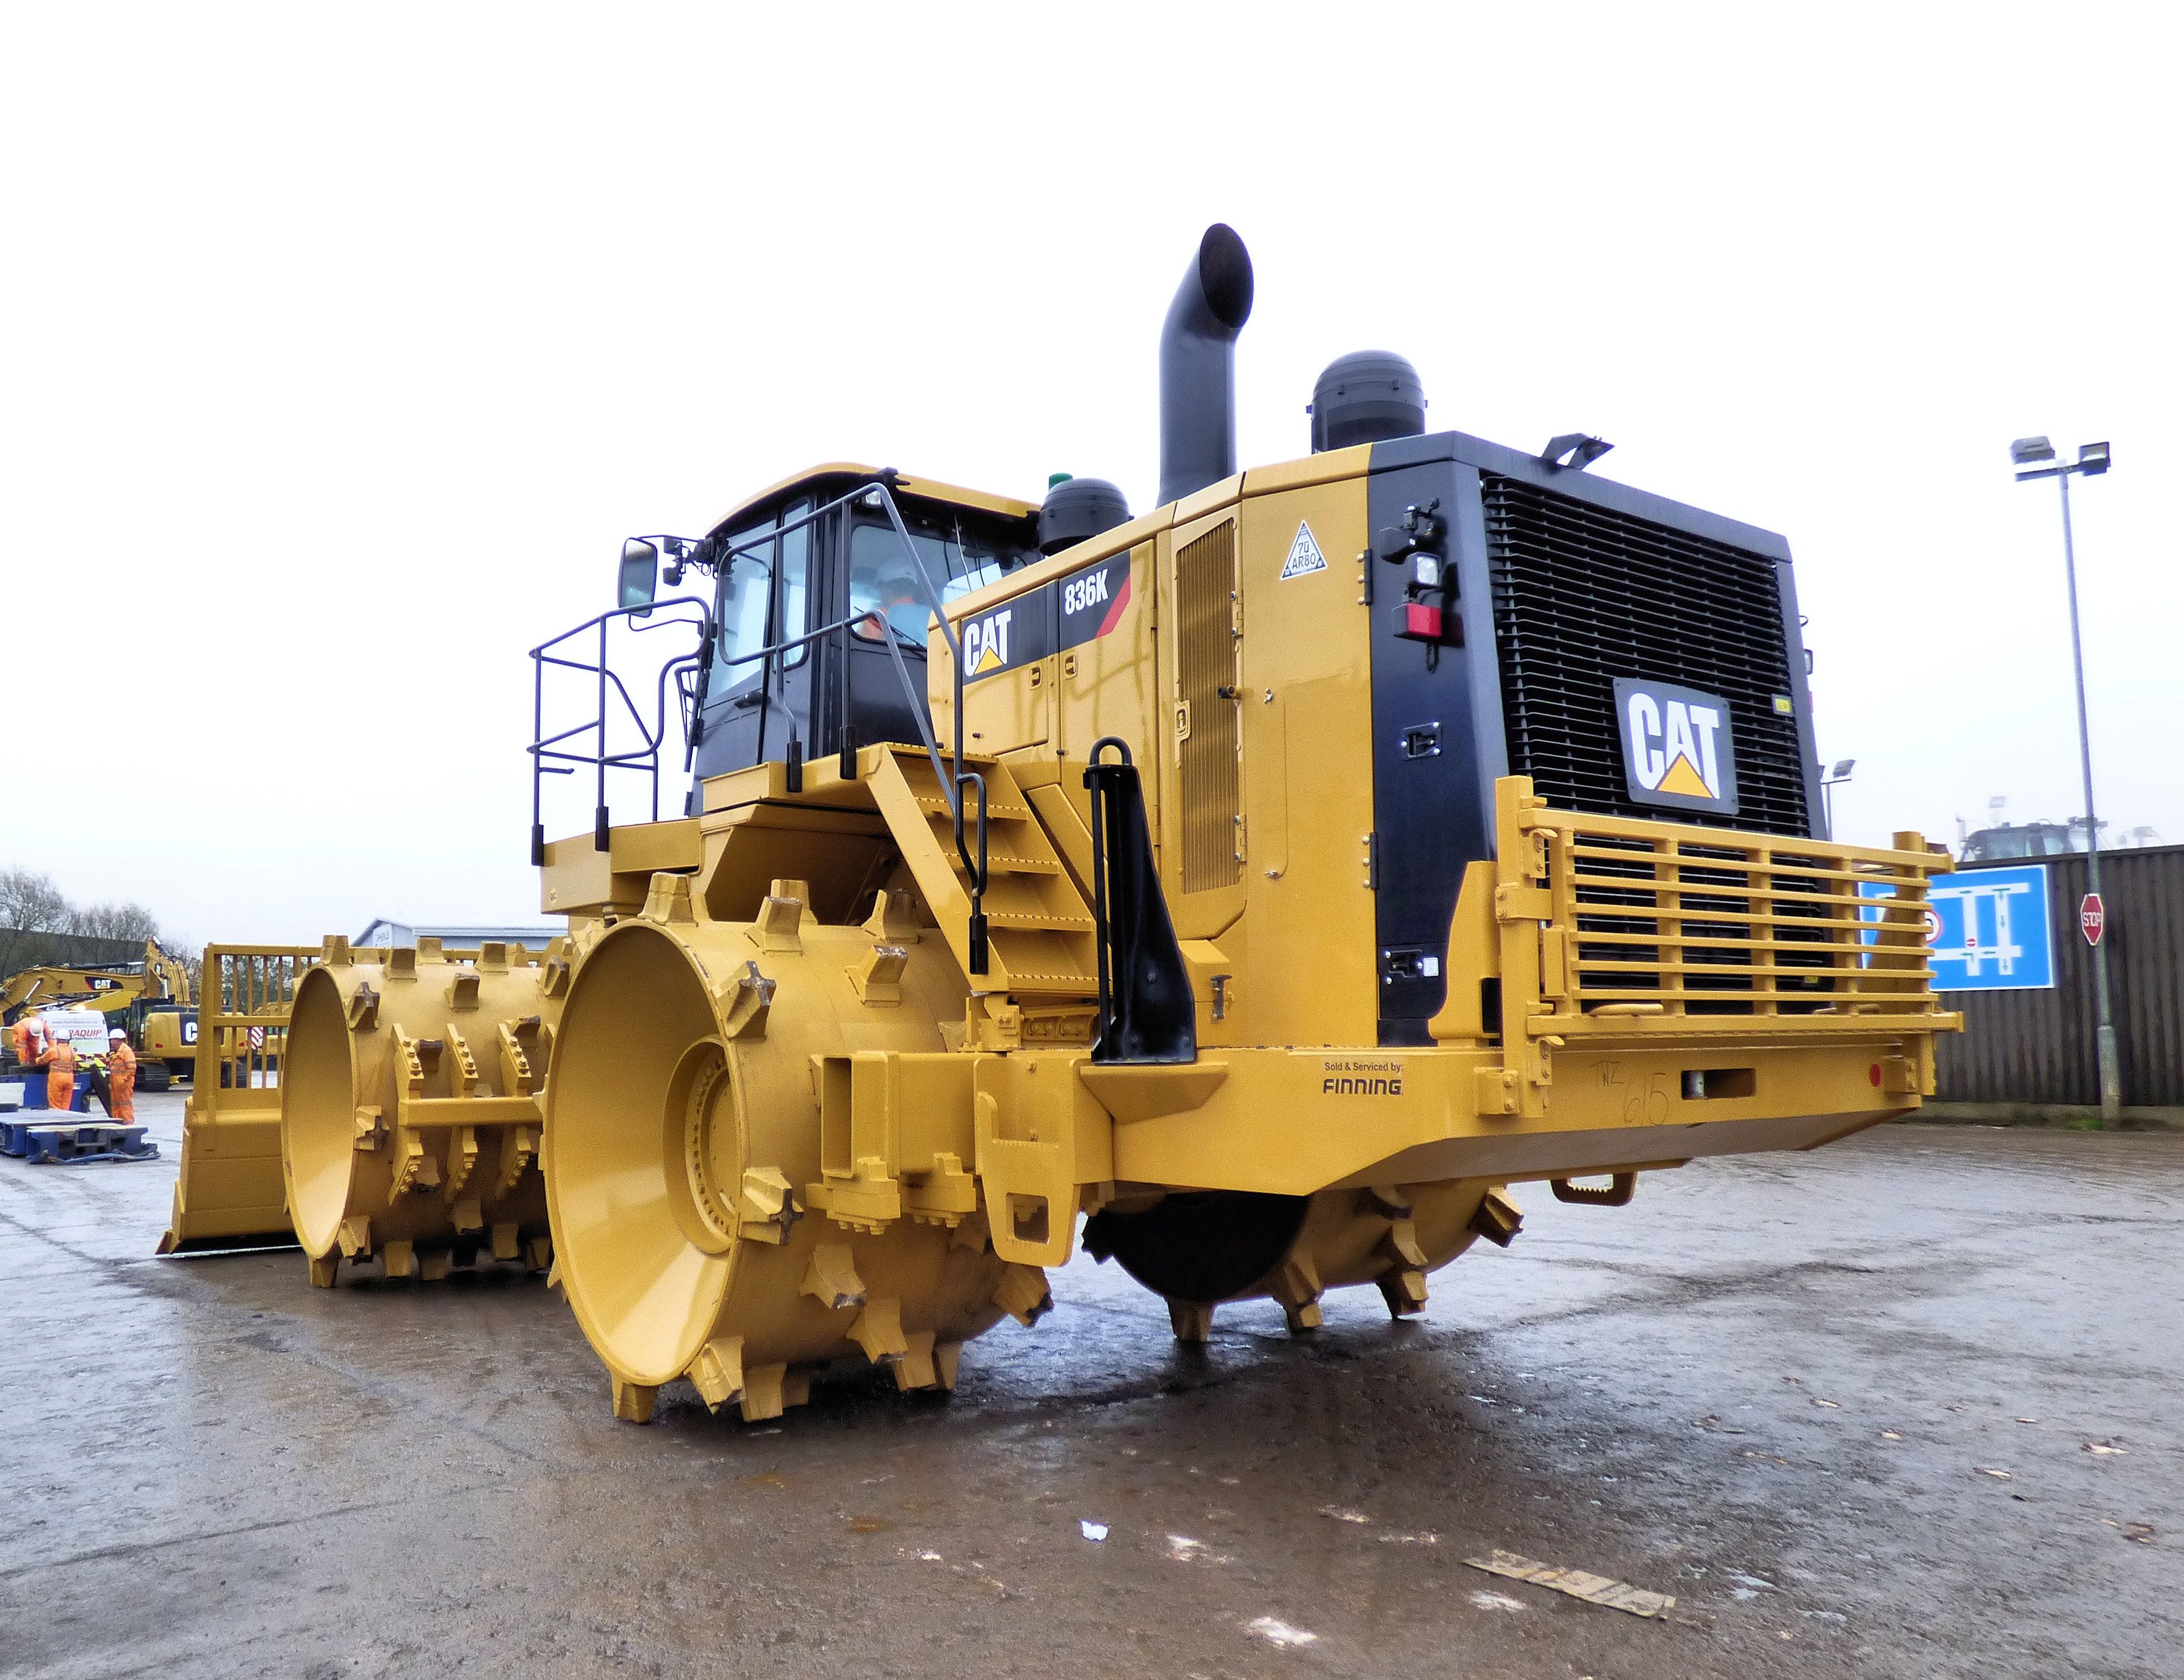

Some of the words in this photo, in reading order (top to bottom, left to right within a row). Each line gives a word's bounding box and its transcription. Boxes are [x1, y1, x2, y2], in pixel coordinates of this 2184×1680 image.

[1065, 569, 1108, 615] 836K
[964, 610, 1011, 676] CAT
[1629, 693, 1720, 799] CAT
[2083, 912, 2101, 927] STOP
[95, 980, 111, 989] CAT
[1325, 1062, 1342, 1071] Sold
[1345, 1062, 1351, 1070] &
[1353, 1062, 1388, 1071] Serviced
[1323, 1078, 1402, 1095] FINNING
